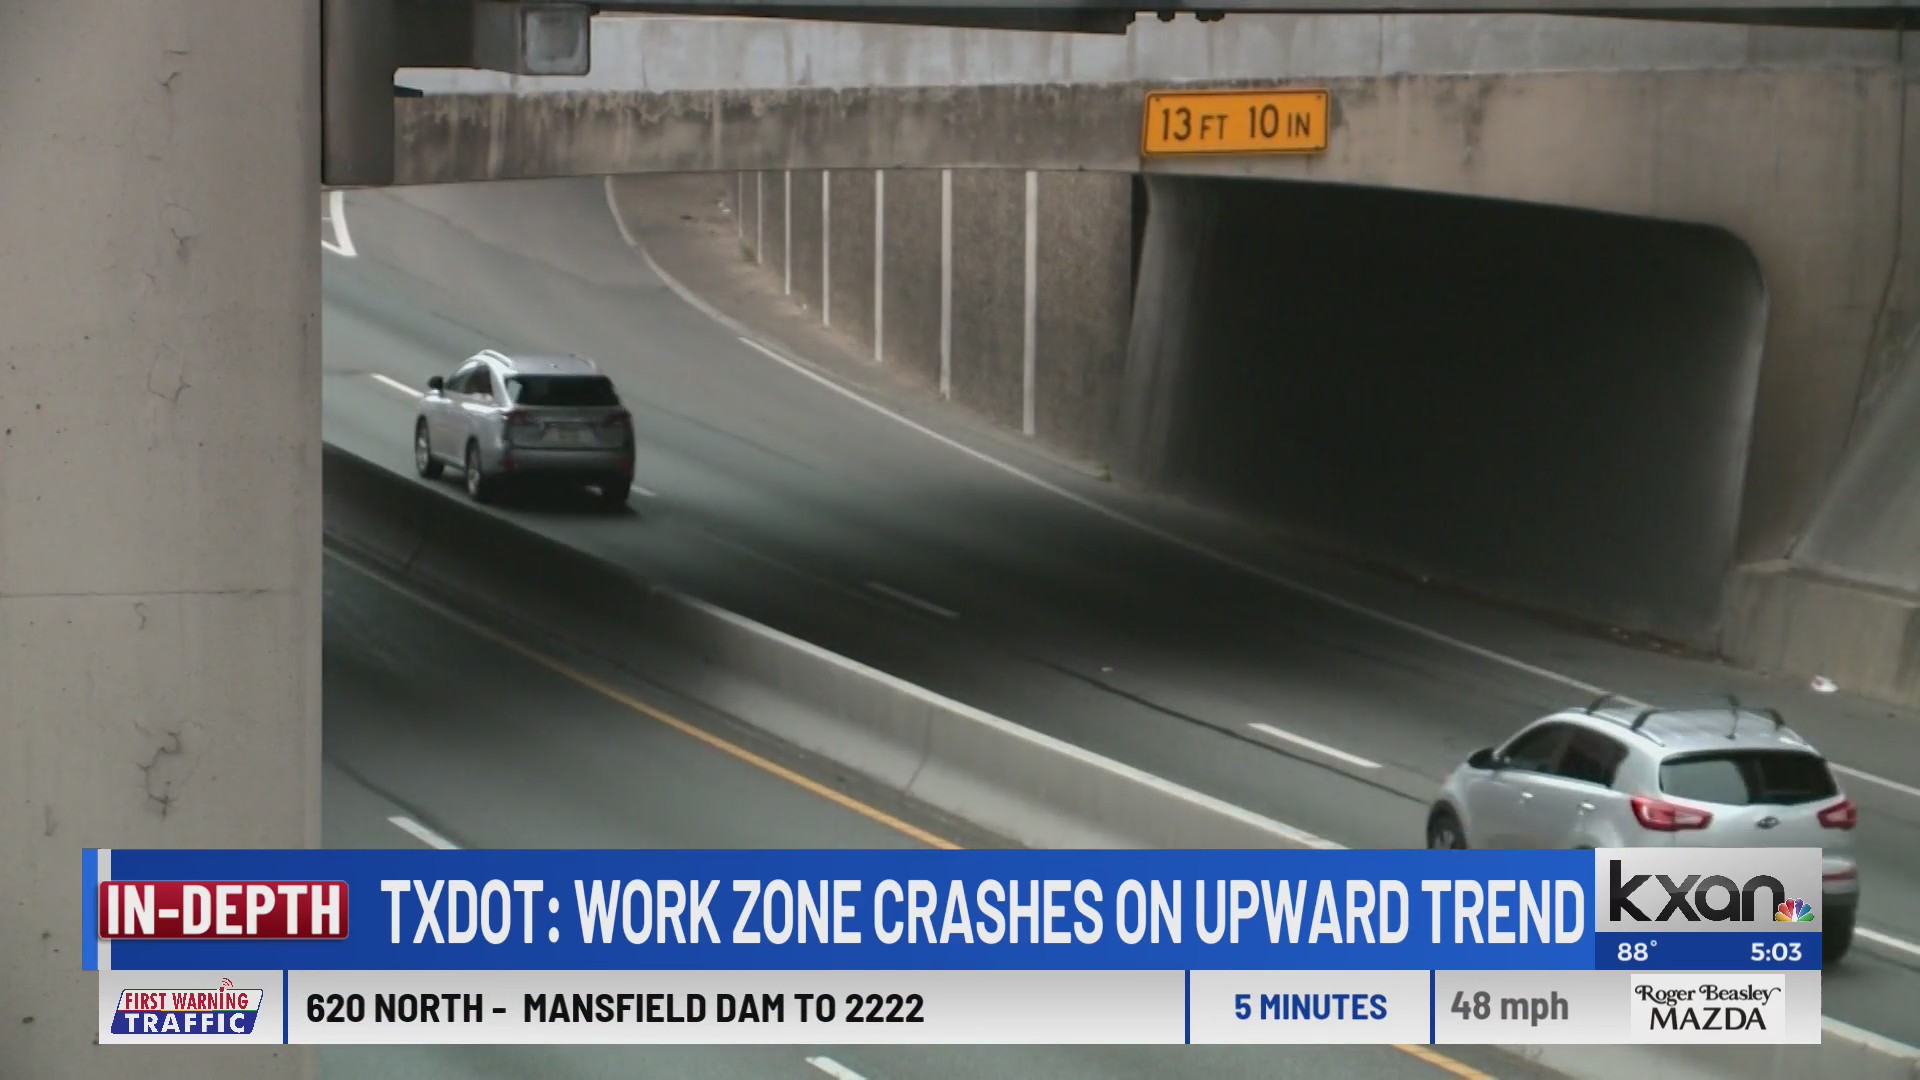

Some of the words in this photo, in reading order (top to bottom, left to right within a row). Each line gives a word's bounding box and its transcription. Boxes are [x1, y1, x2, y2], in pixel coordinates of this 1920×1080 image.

[1162, 107, 1192, 141] 13
[1200, 114, 1229, 140] FT
[1248, 103, 1279, 138] 10
[1287, 112, 1311, 138] IN
